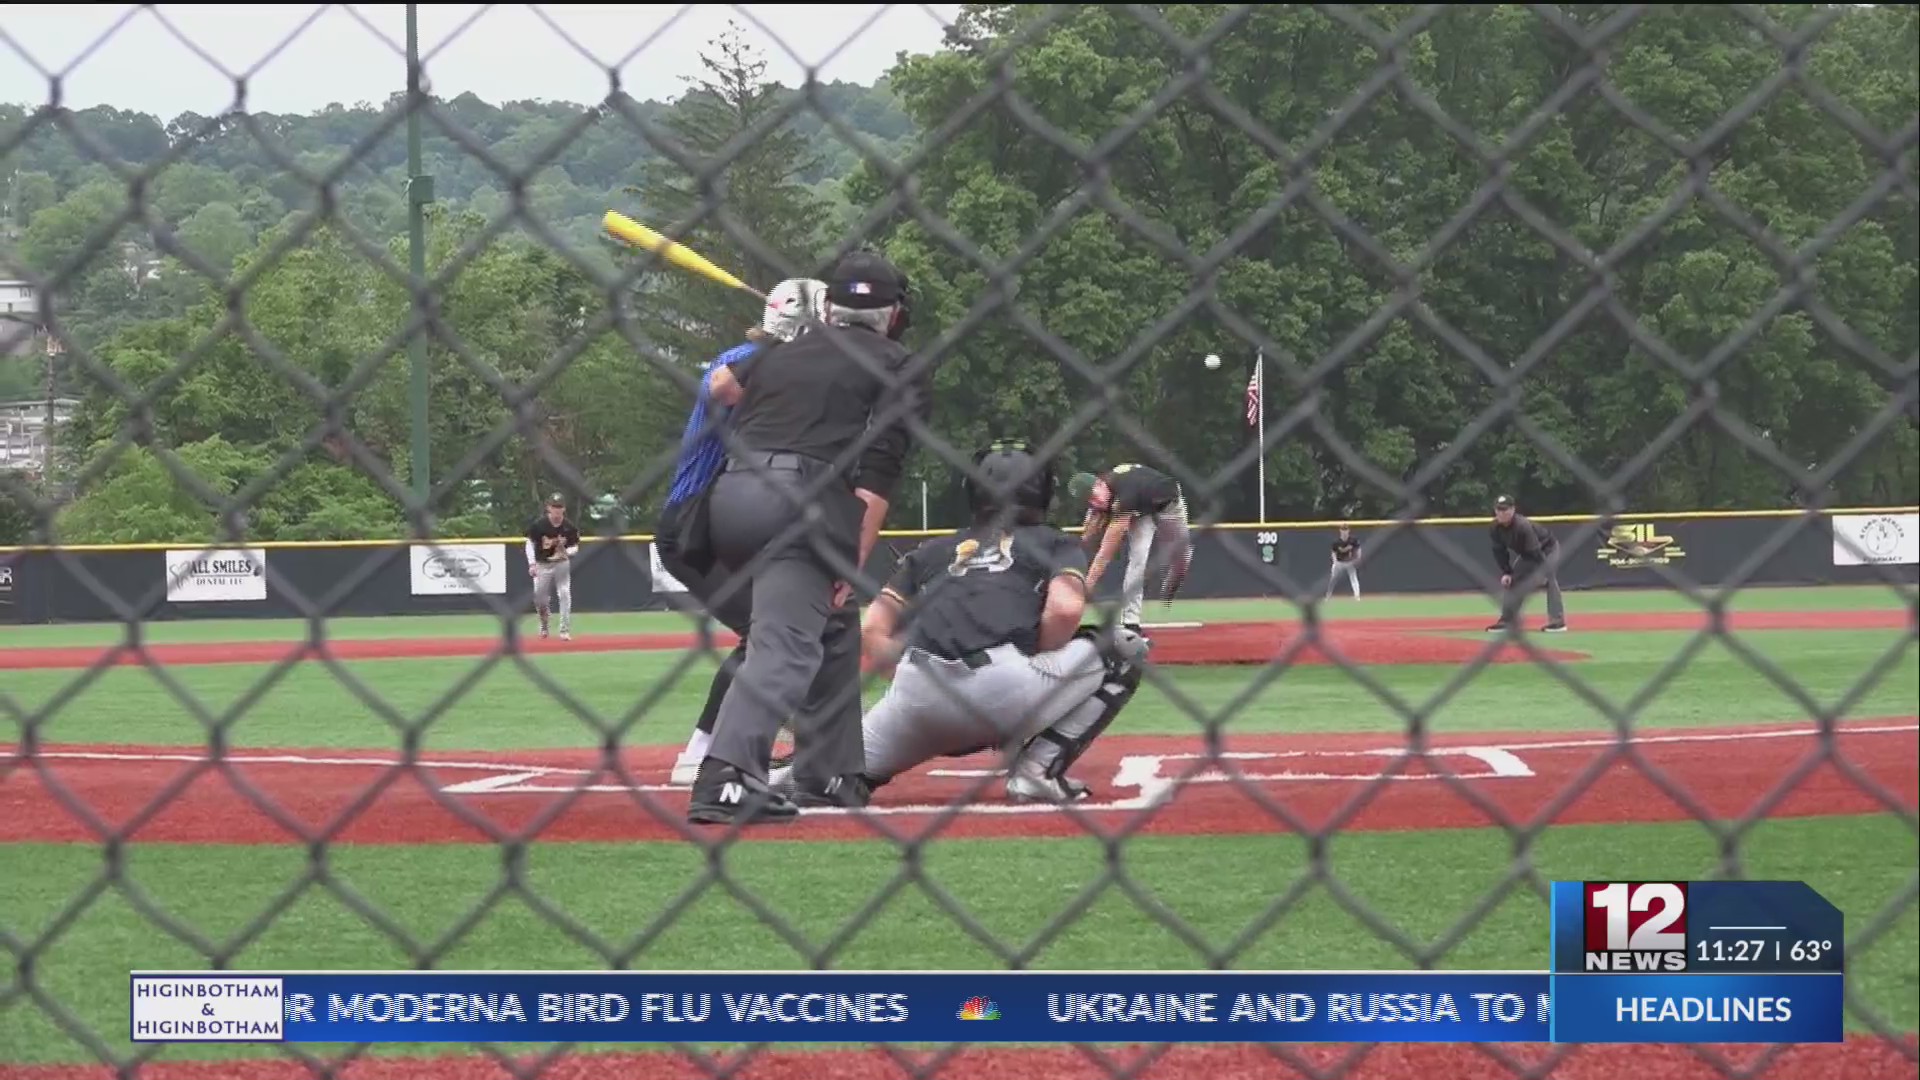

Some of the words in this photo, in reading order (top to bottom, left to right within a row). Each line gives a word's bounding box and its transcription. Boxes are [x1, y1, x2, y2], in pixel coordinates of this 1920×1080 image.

[1257, 532, 1278, 545] 390
[190, 560, 211, 574] ALL
[212, 560, 252, 574] SMILES
[719, 782, 742, 804] N
